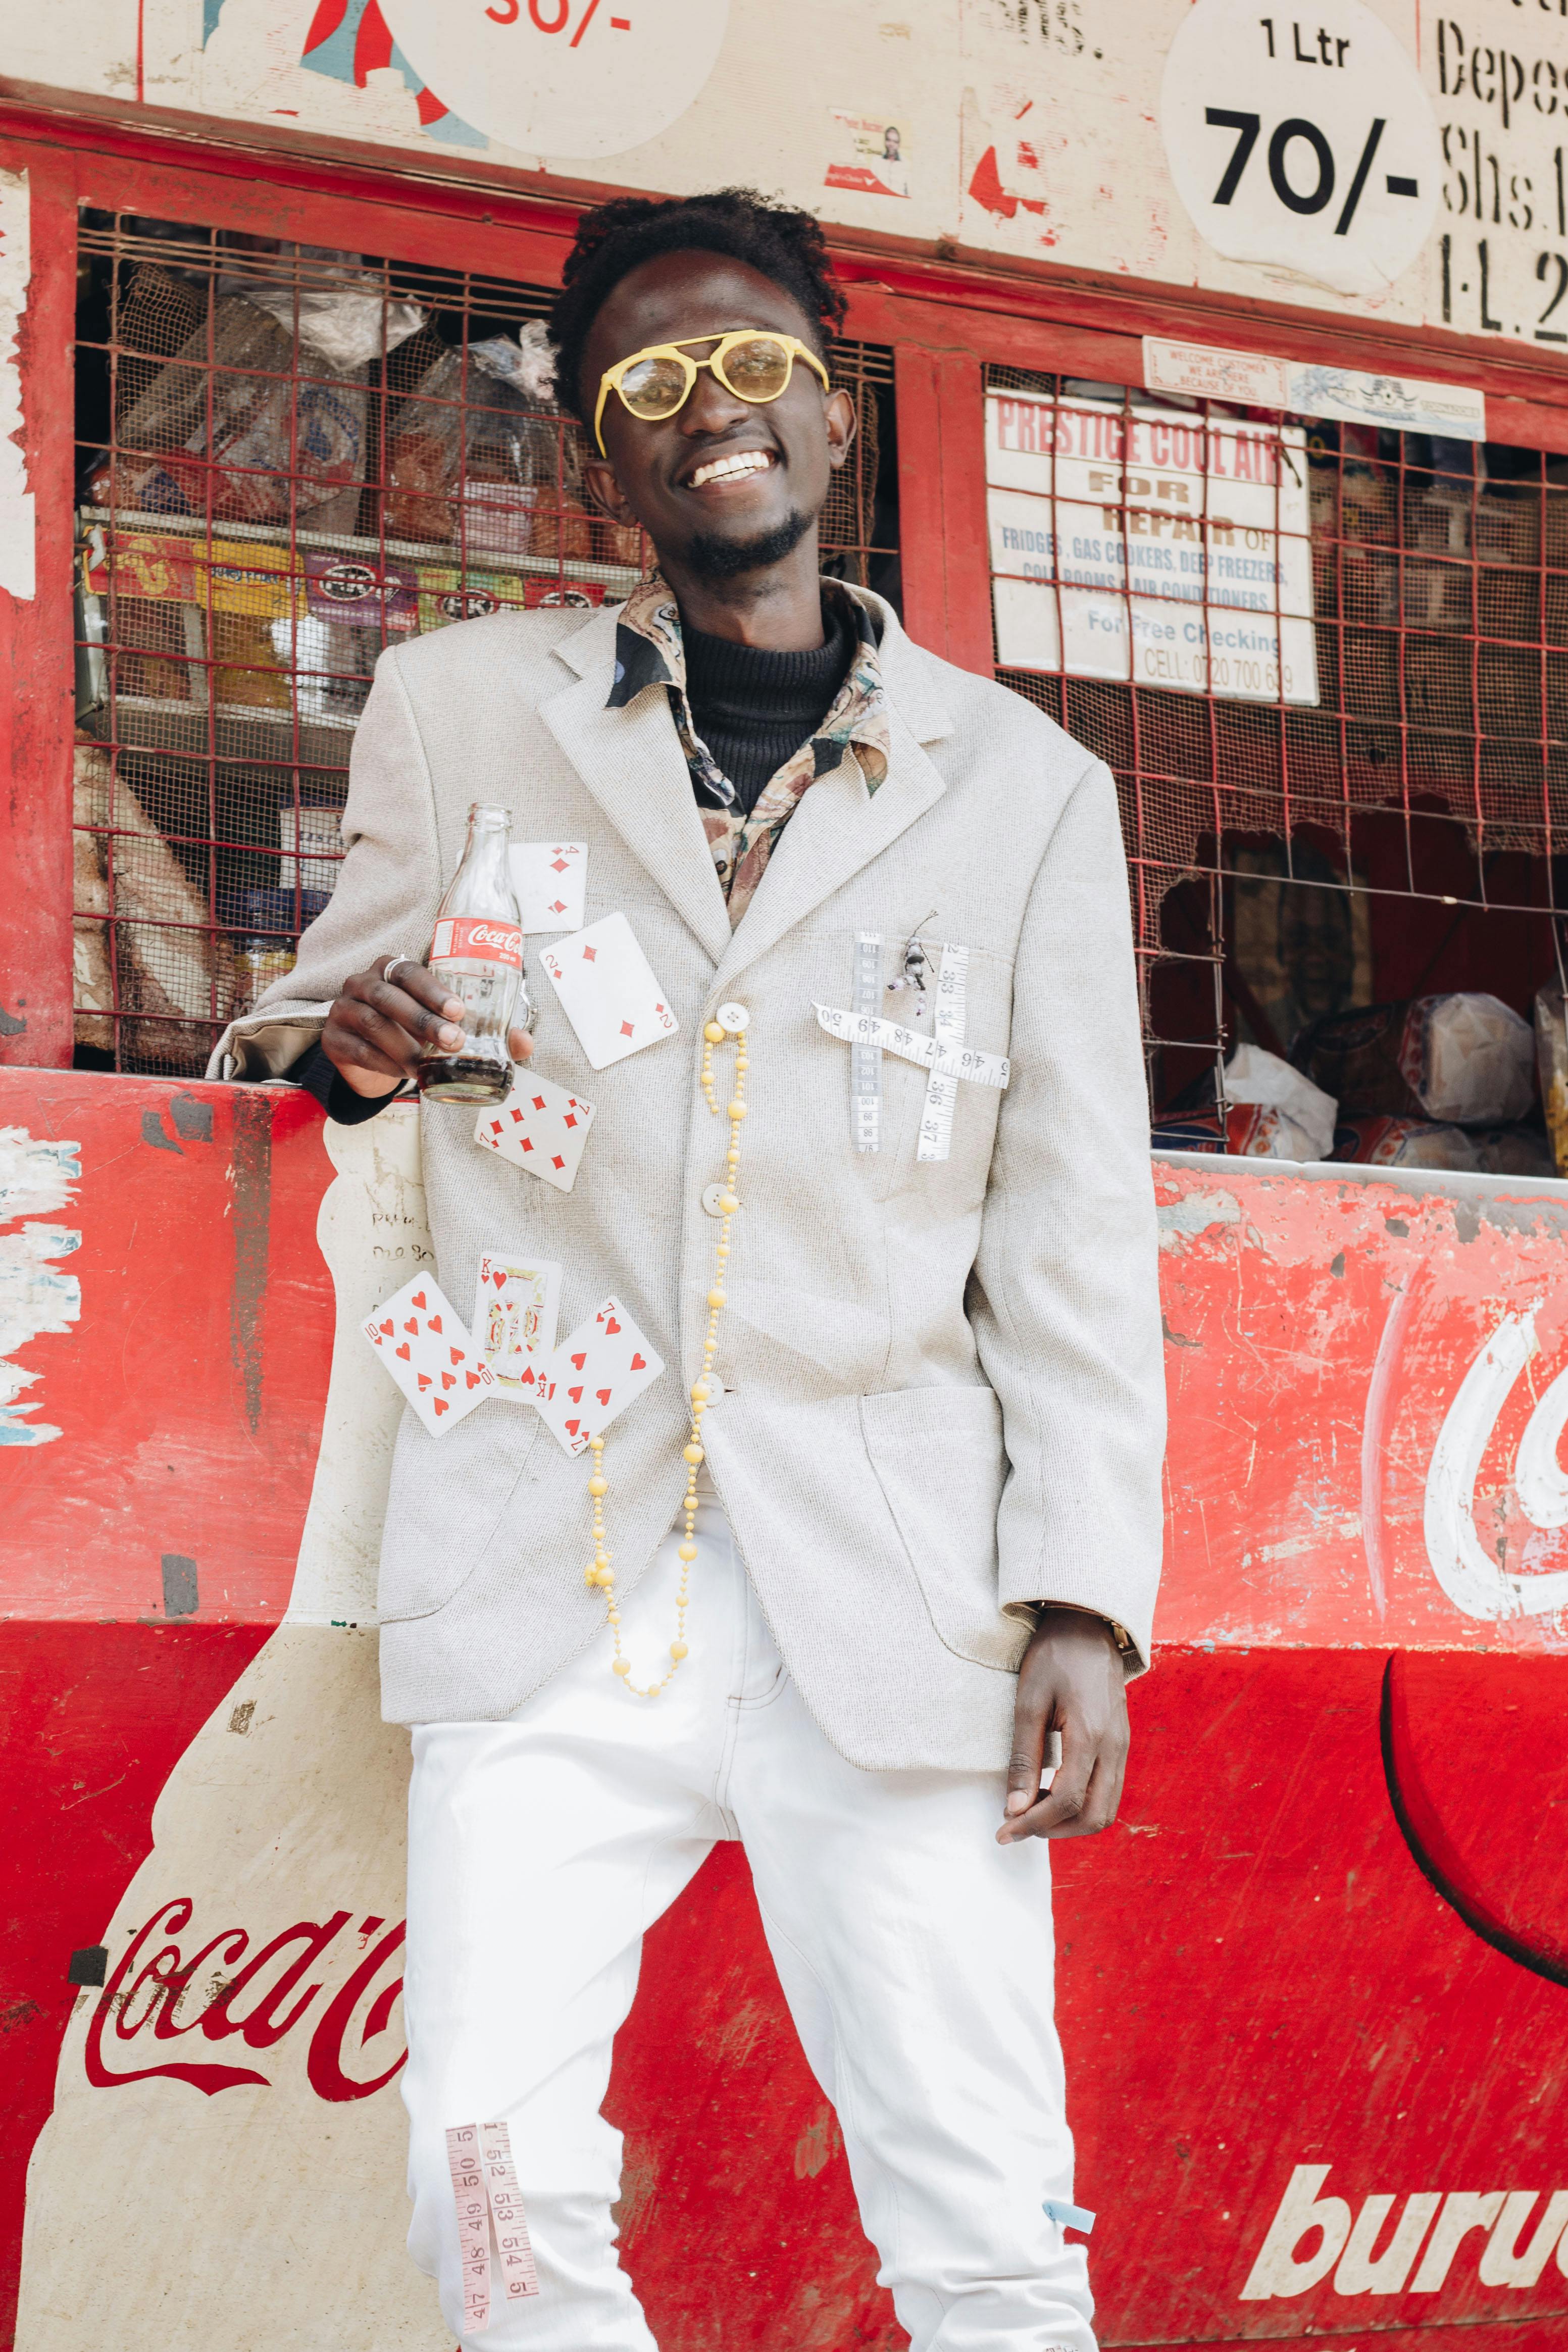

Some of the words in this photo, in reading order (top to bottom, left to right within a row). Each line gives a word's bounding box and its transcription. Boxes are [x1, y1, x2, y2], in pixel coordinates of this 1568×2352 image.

[1260, 19, 1275, 57] 1
[1293, 23, 1350, 68] Ltr
[1205, 107, 1419, 235] 70/-
[1170, 350, 1215, 366] WELCOME
[1217, 357, 1267, 374] CUSTOMER
[1180, 376, 1220, 390] BECAUSE
[1223, 382, 1234, 392] OF
[1237, 384, 1257, 396] YOU
[1189, 367, 1202, 376] WE
[1206, 368, 1223, 379] ARE
[1228, 371, 1250, 384] HERE
[998, 397, 1141, 462] PRESTIGE
[1150, 419, 1226, 475] COOL
[1089, 470, 1189, 504] FOR
[1103, 502, 1235, 546] REPAIR
[1245, 527, 1271, 552] OF
[1073, 537, 1101, 562] GAS
[1064, 568, 1117, 596] ROOMS
[1134, 577, 1157, 602] AIR
[1161, 581, 1269, 612] CONDTIONERS
[1088, 610, 1122, 634] For
[1131, 614, 1176, 640] Free
[1144, 647, 1190, 681] CELL:
[1233, 659, 1261, 690] 700
[565, 845, 580, 855] 4
[545, 955, 559, 970] 2
[660, 1013, 673, 1029] 2
[481, 1258, 492, 1274] K
[602, 1302, 616, 1315] 7
[365, 1323, 378, 1340] 10
[536, 1382, 547, 1398] K
[1238, 2164, 1568, 2300] buru
